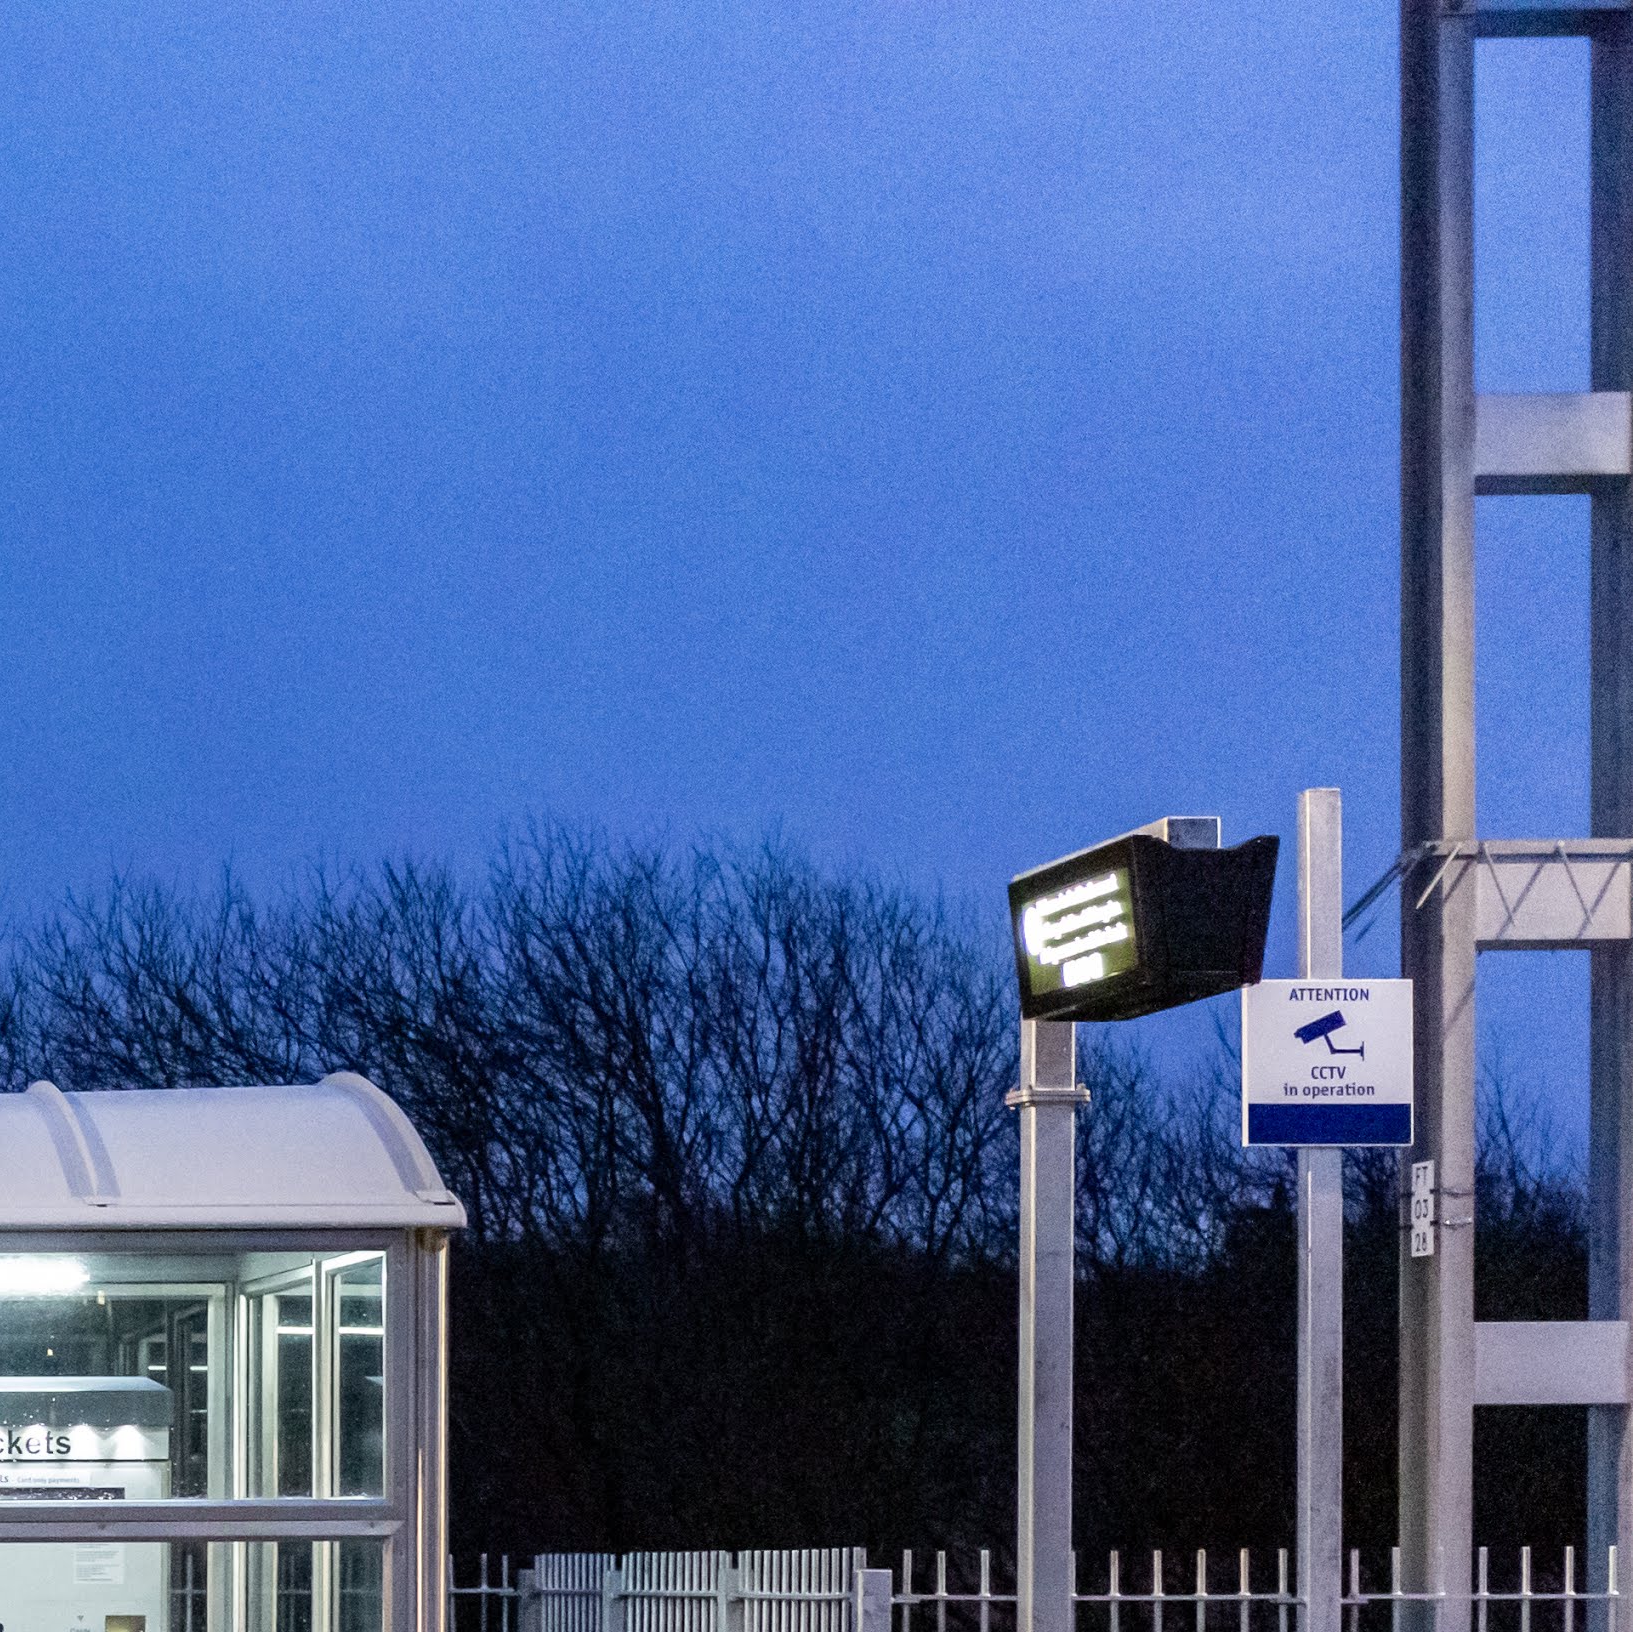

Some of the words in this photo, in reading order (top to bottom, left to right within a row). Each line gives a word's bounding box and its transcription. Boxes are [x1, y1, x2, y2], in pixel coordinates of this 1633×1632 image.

[1289, 988, 1370, 1001] ATTENTION
[1311, 1066, 1346, 1080] CCTV
[1284, 1083, 1298, 1096] in
[1303, 1083, 1375, 1099] operation
[1415, 1166, 1428, 1186] FT
[1415, 1199, 1428, 1220] 03
